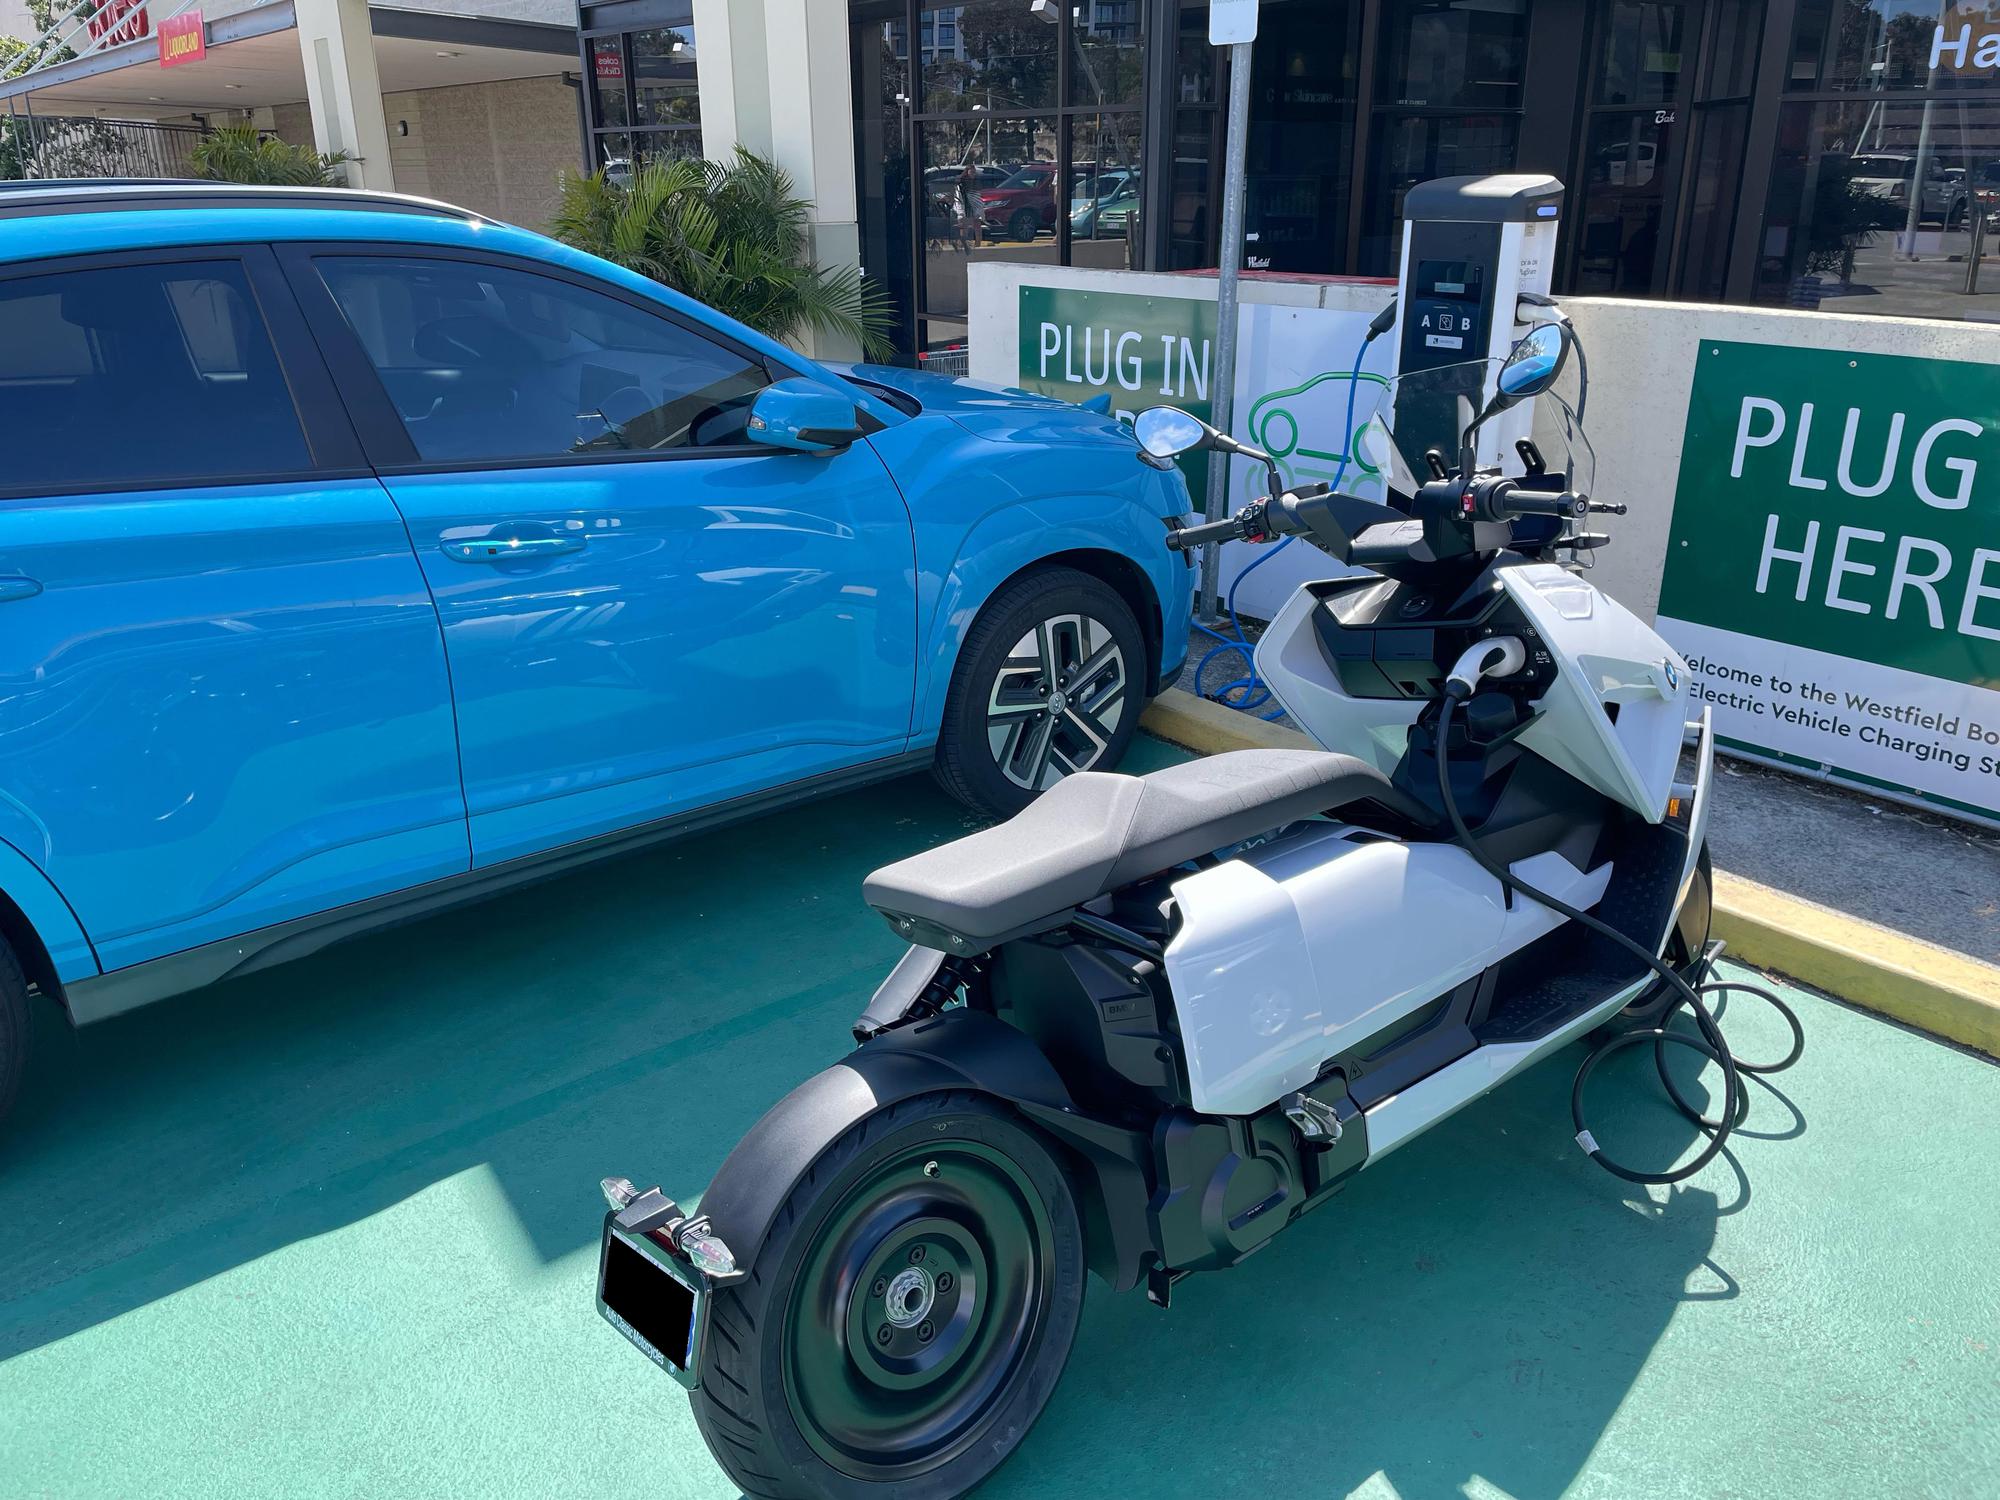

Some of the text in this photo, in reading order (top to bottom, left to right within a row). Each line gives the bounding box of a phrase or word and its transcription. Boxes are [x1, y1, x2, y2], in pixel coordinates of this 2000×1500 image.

[1040, 322, 1210, 401] PLUG IN
[1421, 315, 1471, 331] A B
[1730, 396, 1984, 510] PLUG
[1755, 513, 2000, 642] HERE
[1689, 682, 1765, 715] Electric
[1771, 702, 1852, 738] Vehicle
[1858, 726, 1971, 772] Charging
[1770, 675, 1793, 694] to
[1800, 682, 1837, 705] the
[1845, 691, 1960, 736] Westfield
[1967, 722, 2000, 745] Bo
[632, 1328, 665, 1365] Motorcycles
